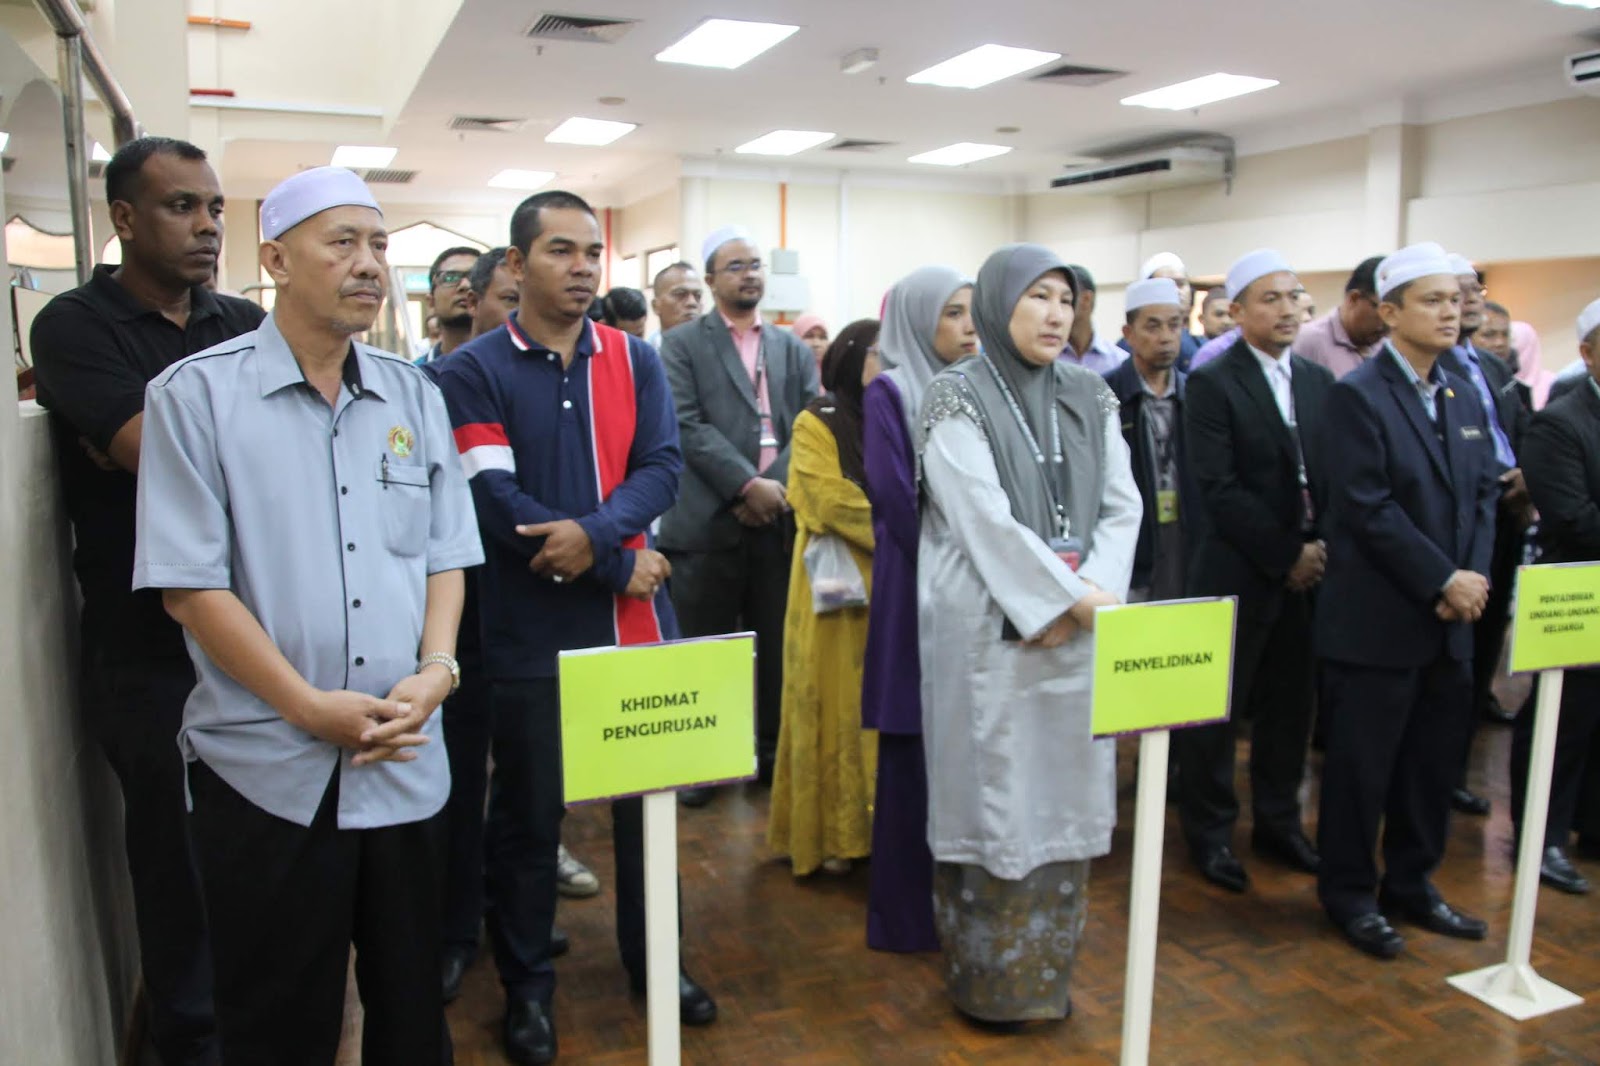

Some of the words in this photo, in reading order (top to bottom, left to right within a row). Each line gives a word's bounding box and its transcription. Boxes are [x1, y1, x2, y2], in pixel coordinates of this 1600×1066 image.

[1114, 652, 1213, 673] PENYELIDIKAN
[621, 691, 700, 712] KHIDMAT
[603, 715, 717, 741] PENGURUSAN
